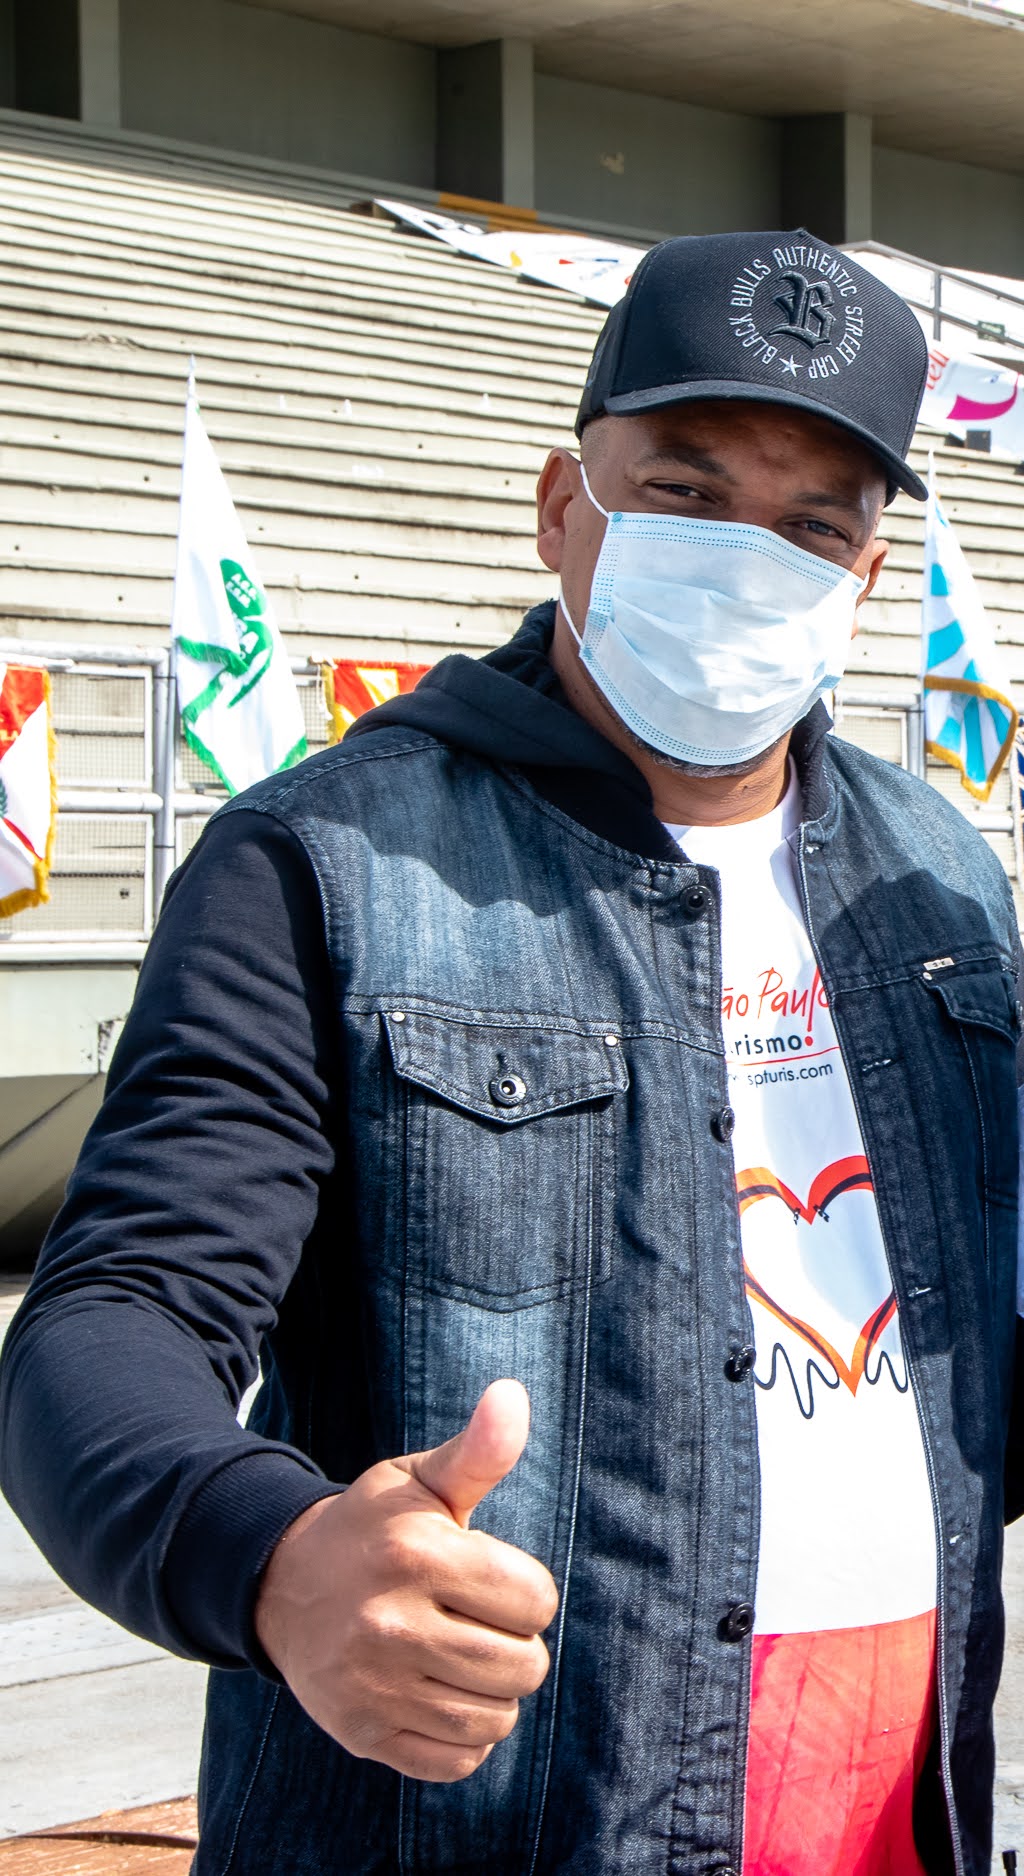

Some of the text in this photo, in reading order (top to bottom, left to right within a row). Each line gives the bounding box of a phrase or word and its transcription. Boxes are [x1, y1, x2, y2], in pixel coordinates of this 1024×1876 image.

[728, 246, 864, 379] BLACK BULLS AUTHENTIC STREET CAP
[735, 1034, 803, 1056] rismo
